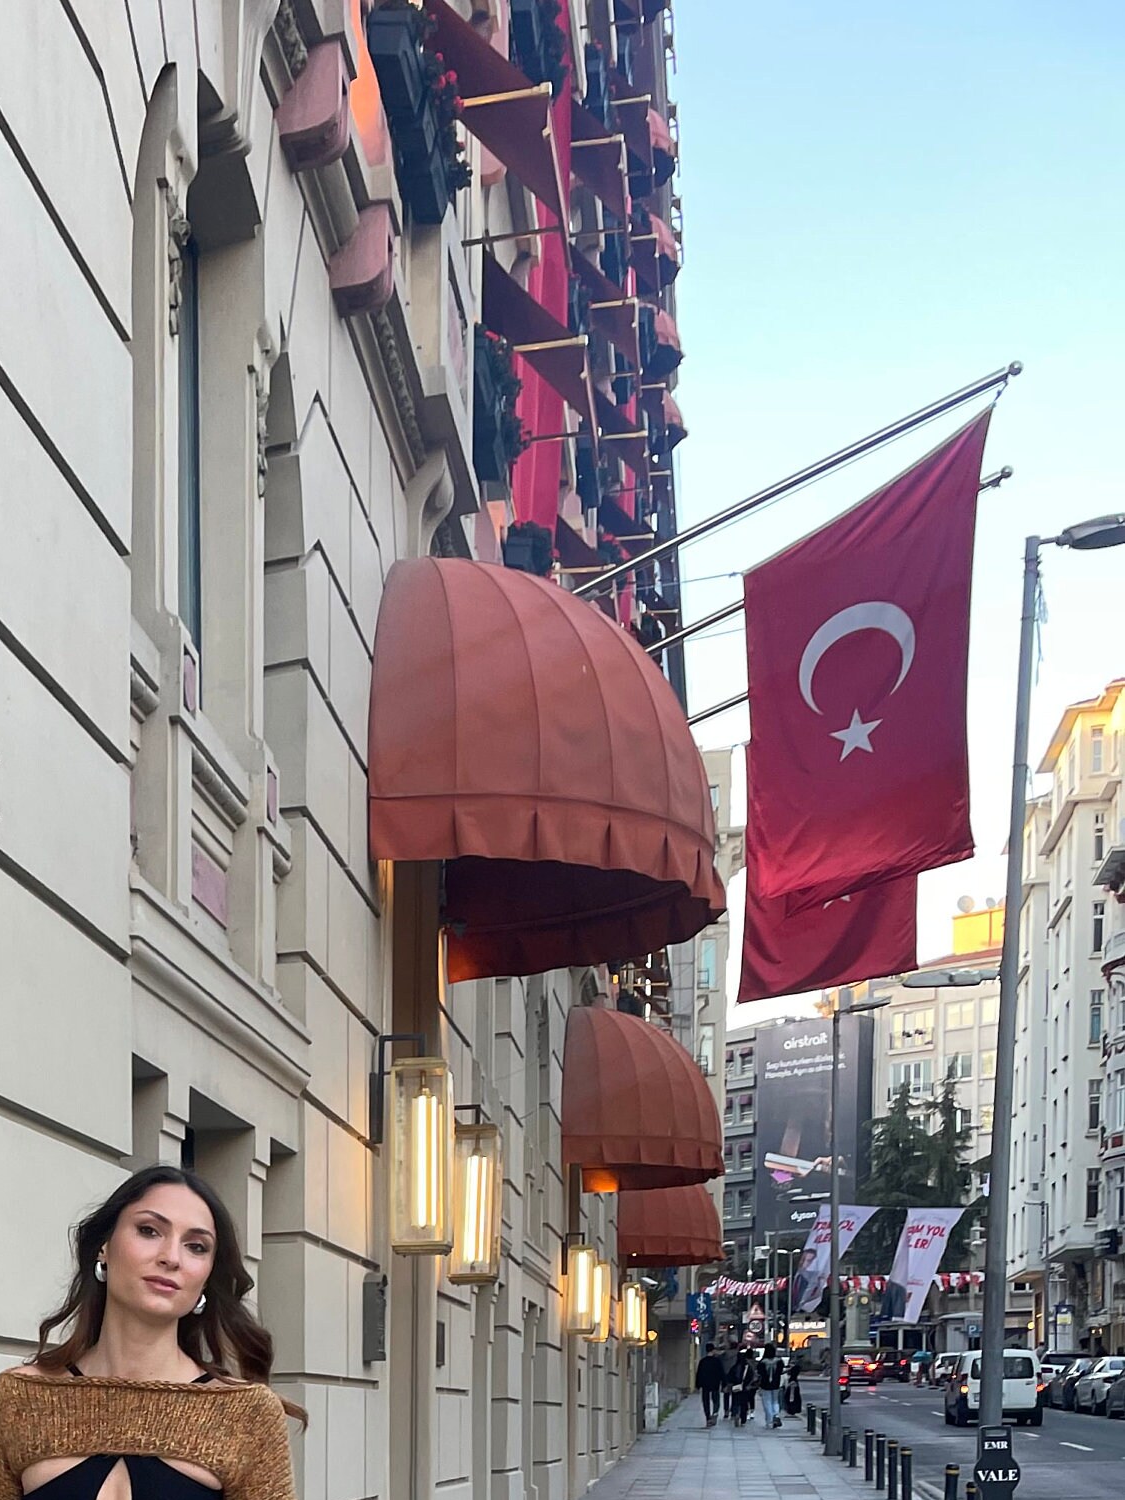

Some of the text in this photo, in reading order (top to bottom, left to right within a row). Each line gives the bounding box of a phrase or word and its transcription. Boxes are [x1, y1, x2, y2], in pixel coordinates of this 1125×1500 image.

[783, 1032, 828, 1050] airstrait
[790, 1210, 817, 1223] dyson
[925, 1225, 947, 1238] YOL
[984, 1441, 1008, 1450] EMR
[977, 1469, 1018, 1482] VALE
